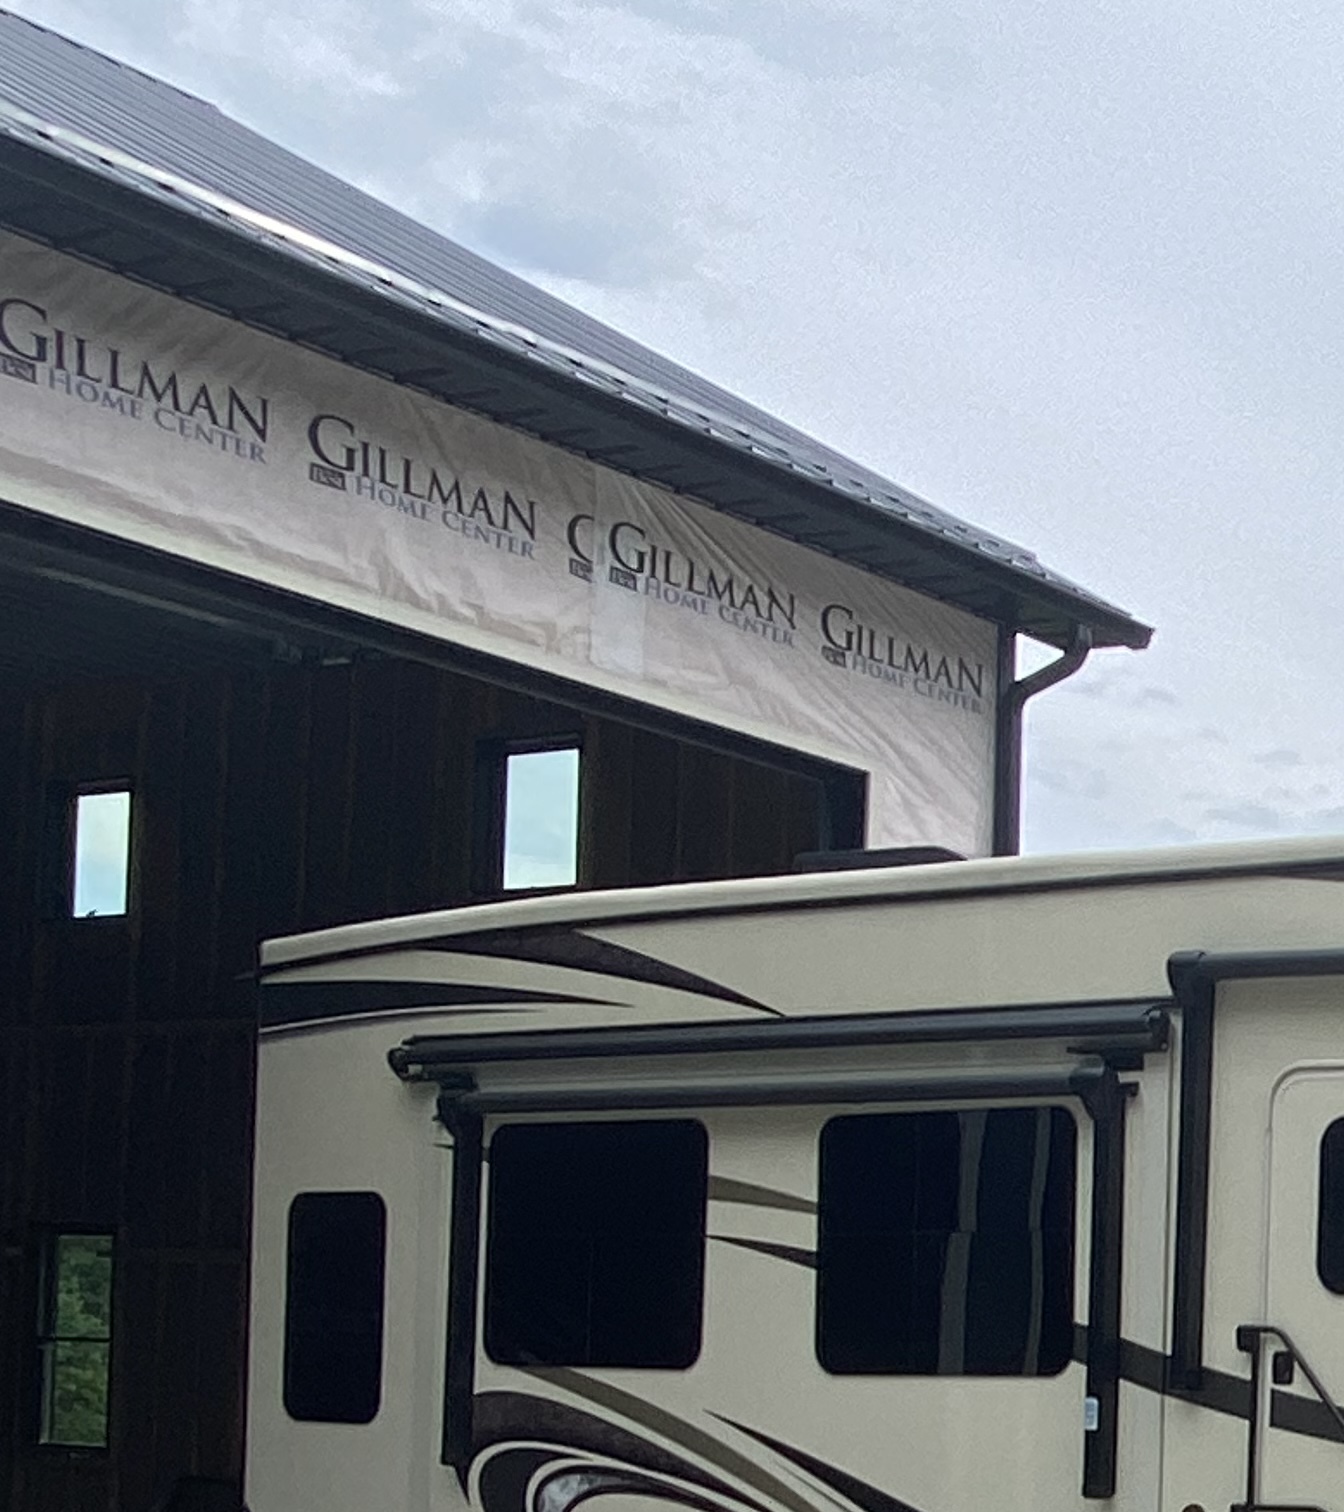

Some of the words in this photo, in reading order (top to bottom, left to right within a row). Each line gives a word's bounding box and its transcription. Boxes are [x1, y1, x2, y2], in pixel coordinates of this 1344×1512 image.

[0, 297, 270, 444] GILLMAN
[48, 368, 144, 420] HOME
[153, 408, 267, 465] CENTER
[307, 414, 538, 541] GILLMAN
[354, 476, 432, 523] HOME
[441, 510, 535, 561] CENTER
[609, 521, 797, 630] GILLMAN
[643, 577, 710, 616] HOME
[718, 605, 795, 648] CENTER
[821, 604, 984, 698] GILLMAN
[852, 653, 909, 689] HOME
